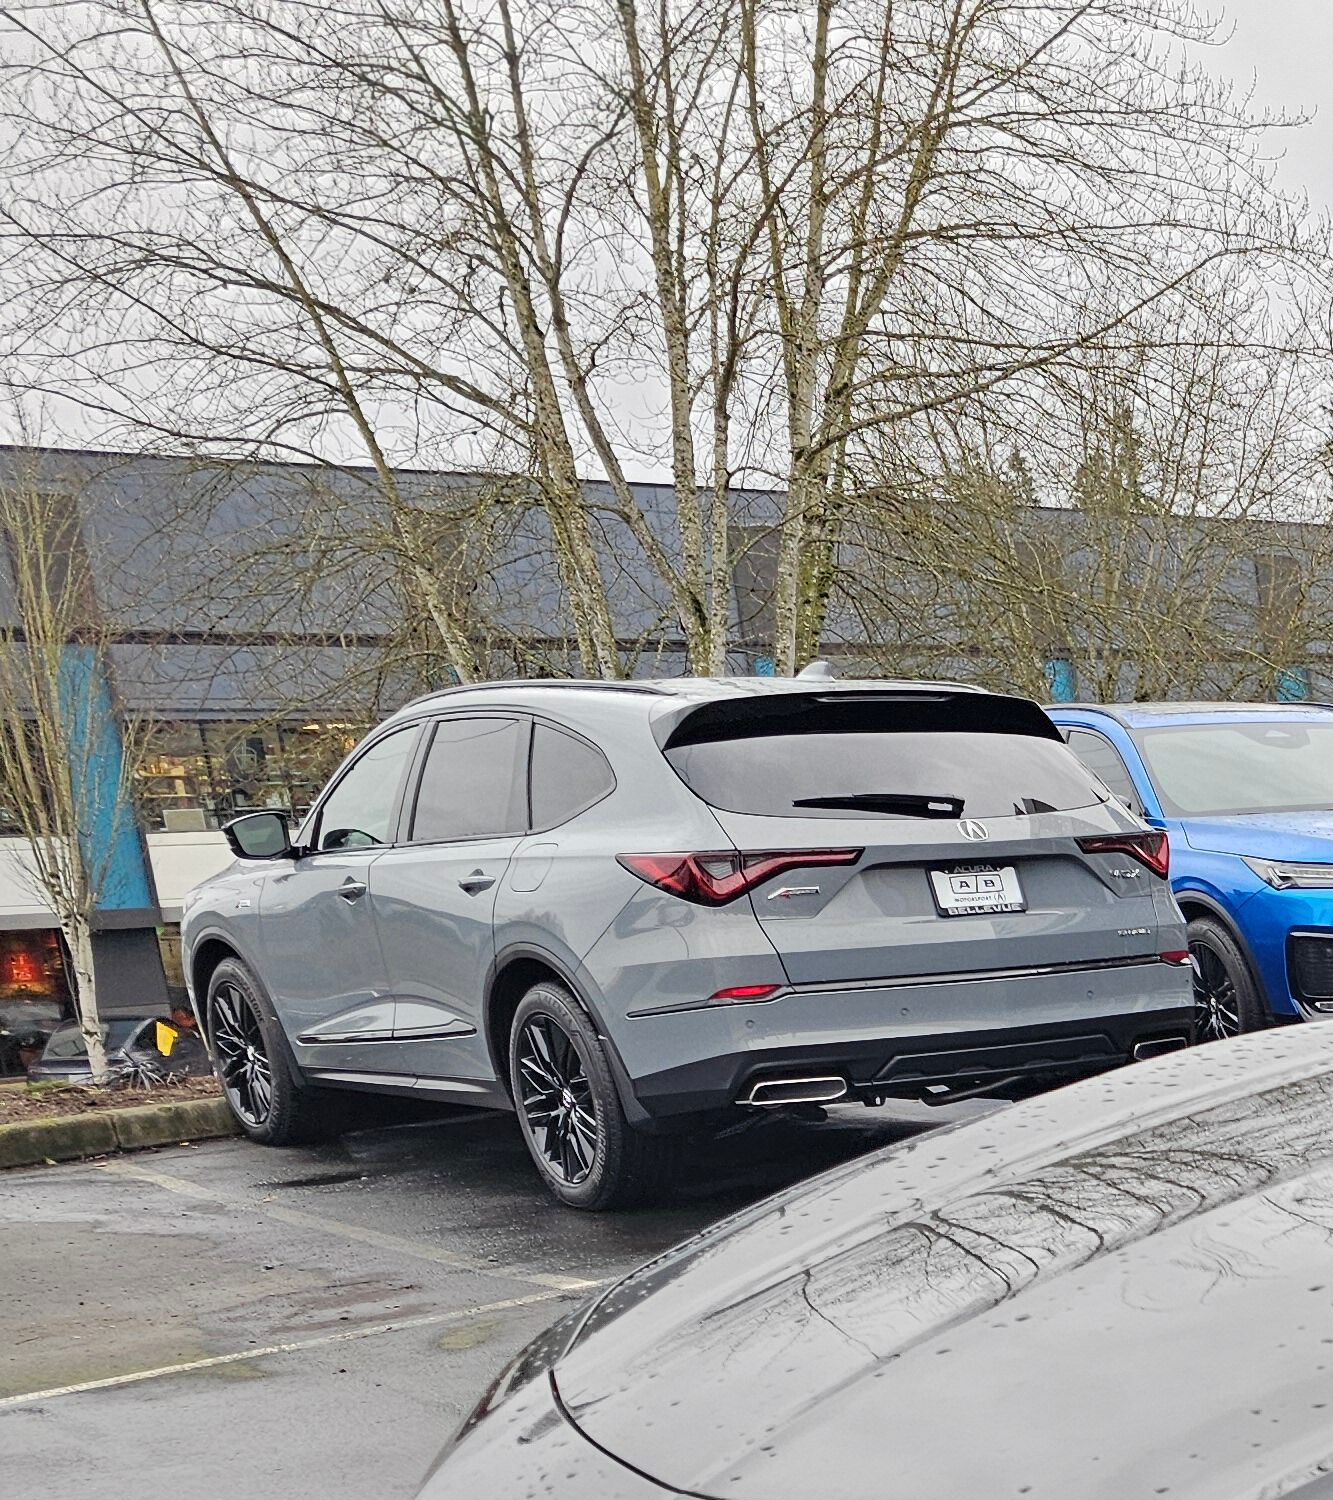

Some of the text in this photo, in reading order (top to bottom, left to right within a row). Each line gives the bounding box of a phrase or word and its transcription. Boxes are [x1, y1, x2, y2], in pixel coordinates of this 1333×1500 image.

[953, 864, 995, 874] ACURA
[959, 879, 996, 889] A B
[948, 903, 1022, 916] BELLEVUE
